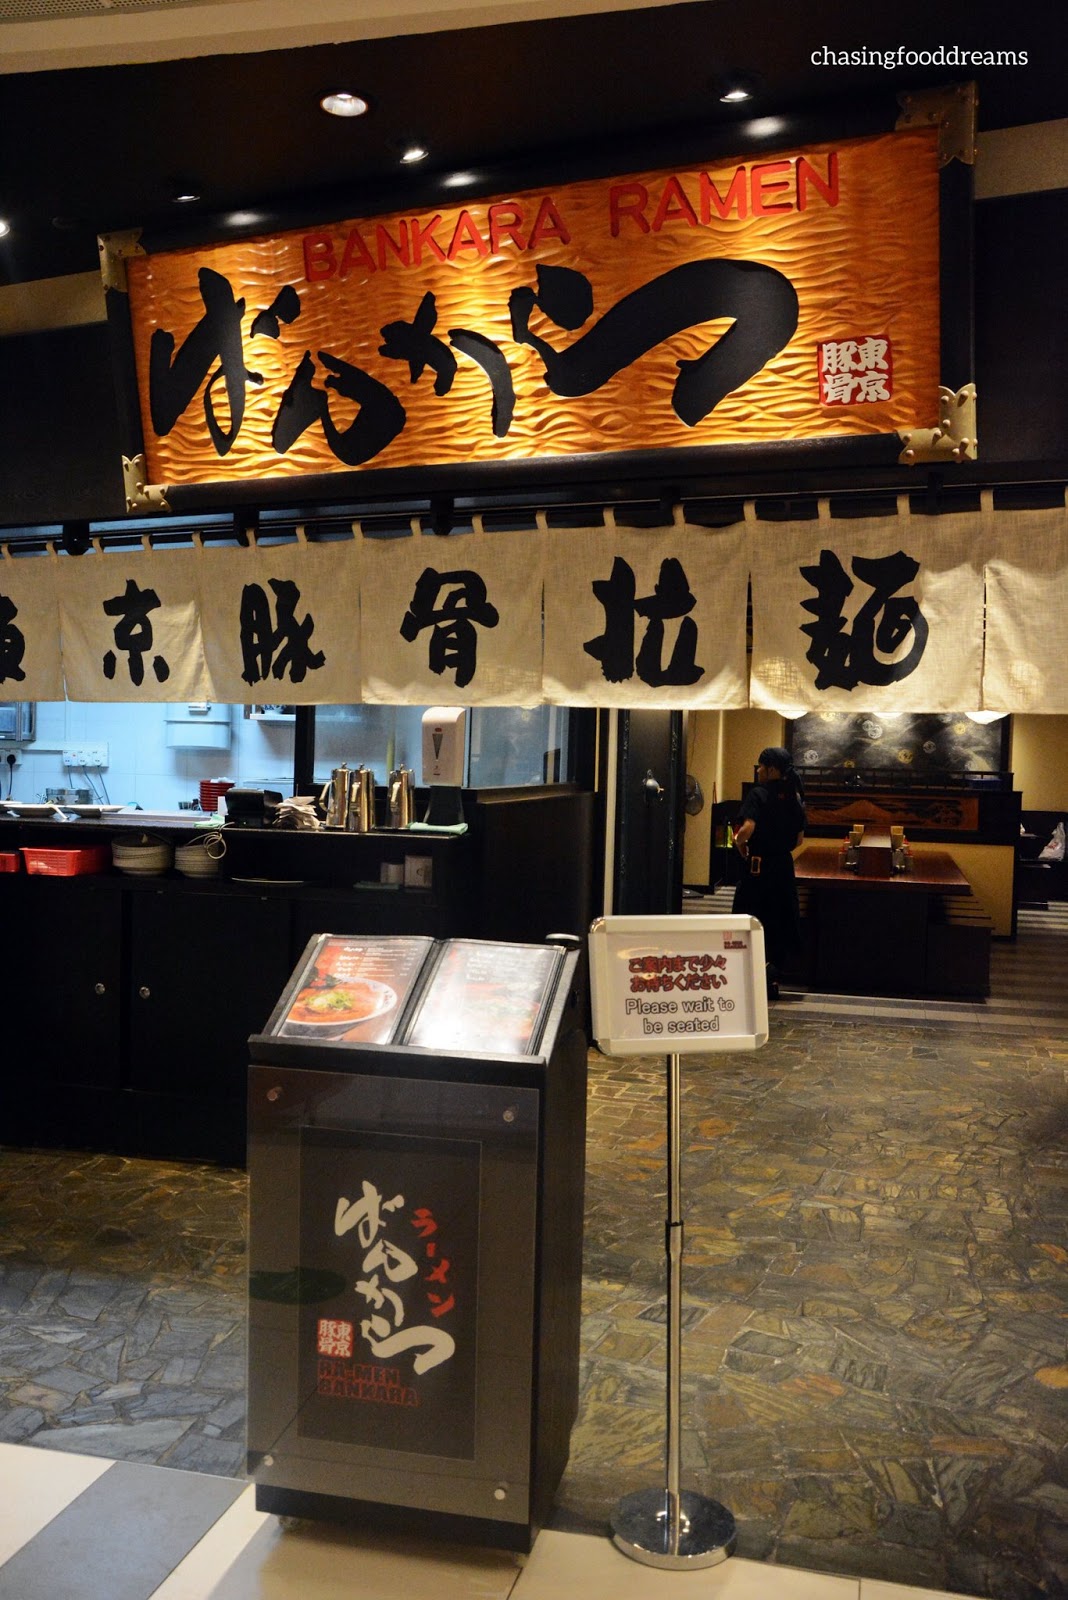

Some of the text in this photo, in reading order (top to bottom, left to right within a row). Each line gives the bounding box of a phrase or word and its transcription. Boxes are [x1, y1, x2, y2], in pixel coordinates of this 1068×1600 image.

[303, 152, 840, 283] BANKARA RAMEN
[630, 973, 728, 992] お待ちください
[625, 996, 735, 1015] Please wait to
[643, 1015, 720, 1034] be seated
[411, 1207, 456, 1318] ラーメン
